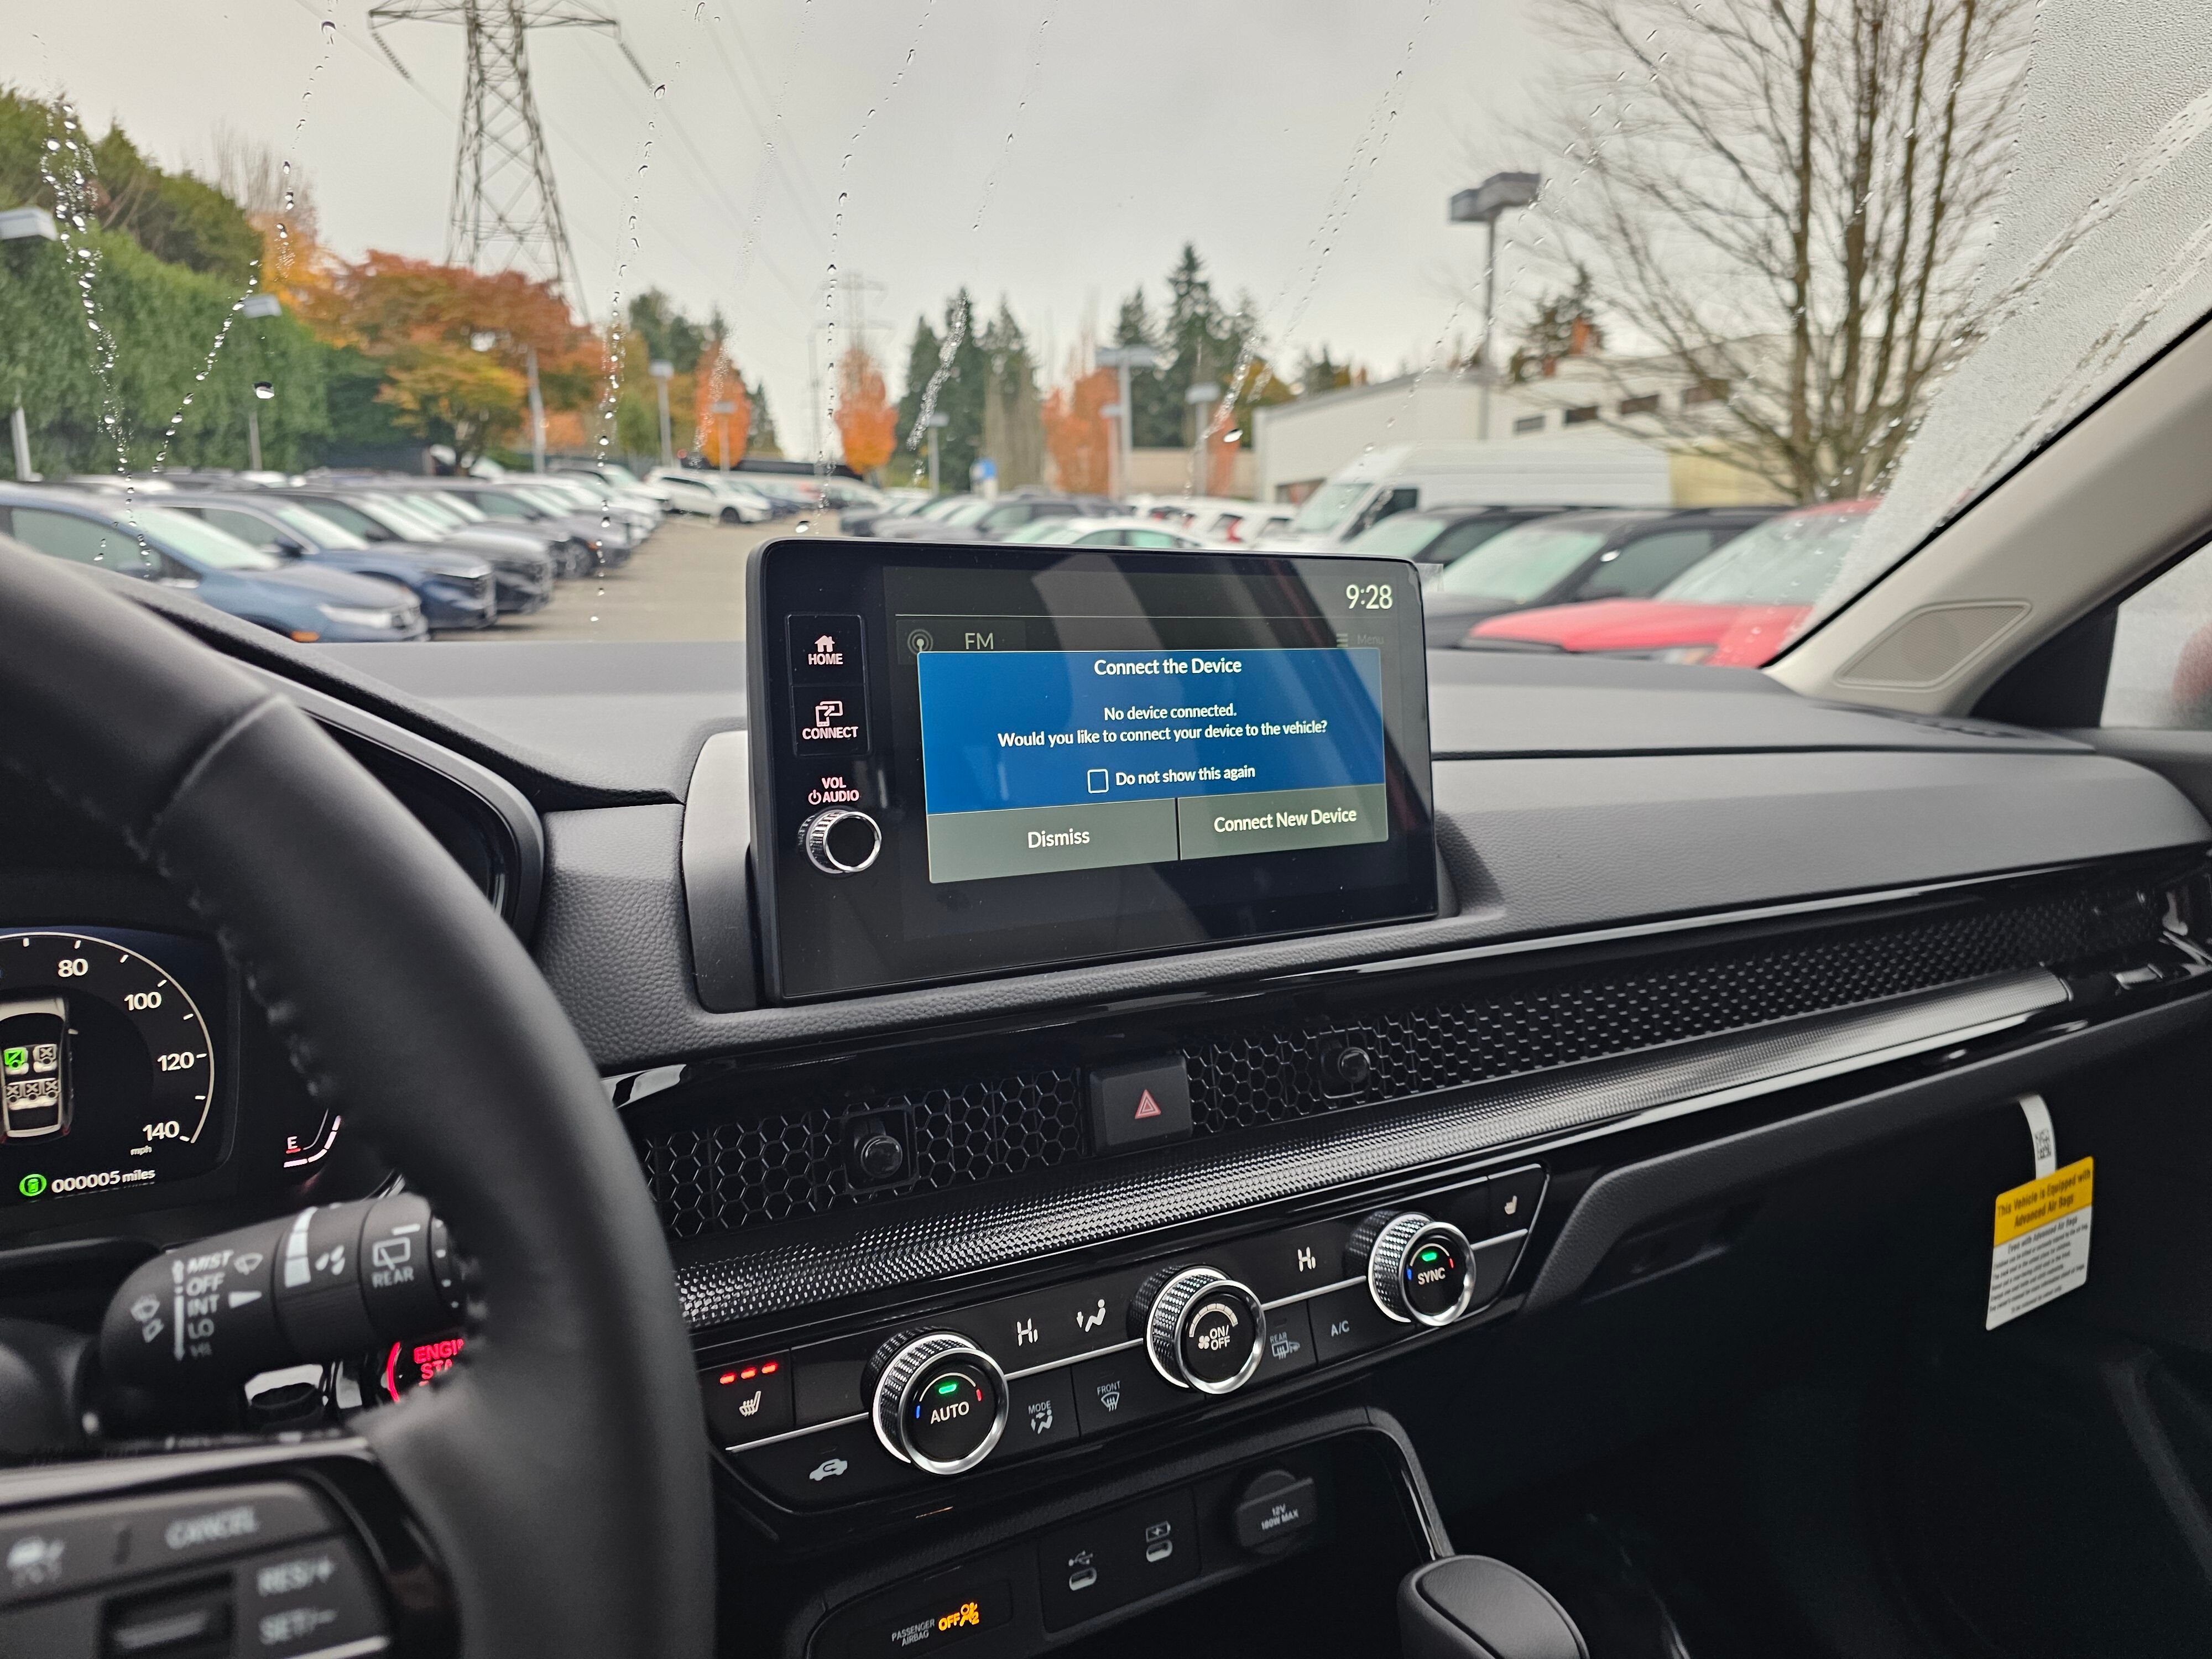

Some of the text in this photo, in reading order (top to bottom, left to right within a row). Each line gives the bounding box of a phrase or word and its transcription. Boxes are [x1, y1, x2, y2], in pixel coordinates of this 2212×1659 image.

[1346, 585, 1393, 609] 9:28
[965, 633, 994, 650] FM
[1358, 634, 1384, 645] Menu
[808, 654, 843, 665] HOME
[1094, 657, 1242, 675] Connect the Device
[1104, 702, 1237, 721] No device connected.
[802, 726, 858, 739] CONNECT
[997, 719, 1328, 748] Would you like to connect your device to the vehicle?
[821, 776, 847, 789] VOL
[1115, 765, 1255, 786] Do not show this again
[822, 789, 859, 803] AUDIO
[1214, 807, 1357, 833] Connect New Device
[1027, 828, 1090, 848] Dismiss
[58, 958, 88, 977] 80
[124, 992, 161, 1010] 100
[158, 1051, 194, 1072] 120
[143, 1121, 180, 1141] 140
[131, 1145, 152, 1155] mph
[288, 1136, 298, 1150] E
[51, 1169, 155, 1193] 000005 miles
[1998, 1202, 2012, 1217] This
[2013, 1192, 2038, 1211] Vehicle
[2047, 1174, 2076, 1197] Equipped
[2014, 1203, 2046, 1229] Advanced
[2048, 1201, 2057, 1214] Air
[187, 1249, 234, 1274] MIST
[186, 1272, 225, 1296] OFF
[372, 1266, 414, 1288] REAR
[1417, 1267, 1446, 1286] SYNC
[187, 1294, 220, 1317] INT
[188, 1318, 214, 1339] LO
[1209, 1324, 1229, 1339] ON/
[1270, 1332, 1287, 1344] REAR
[1331, 1320, 1350, 1337] A/C
[1211, 1335, 1230, 1350] OFF
[1097, 1380, 1120, 1396] FRONT
[931, 1401, 969, 1425] AUTO
[1028, 1400, 1051, 1415] MODE
[1272, 1503, 1286, 1516] 12V
[1281, 1509, 1299, 1522] MAX
[165, 1507, 256, 1549] CANCEL
[891, 1619, 935, 1642] PASSENGER
[938, 1612, 960, 1631] OFF
[901, 1630, 930, 1647] AIRBAG
